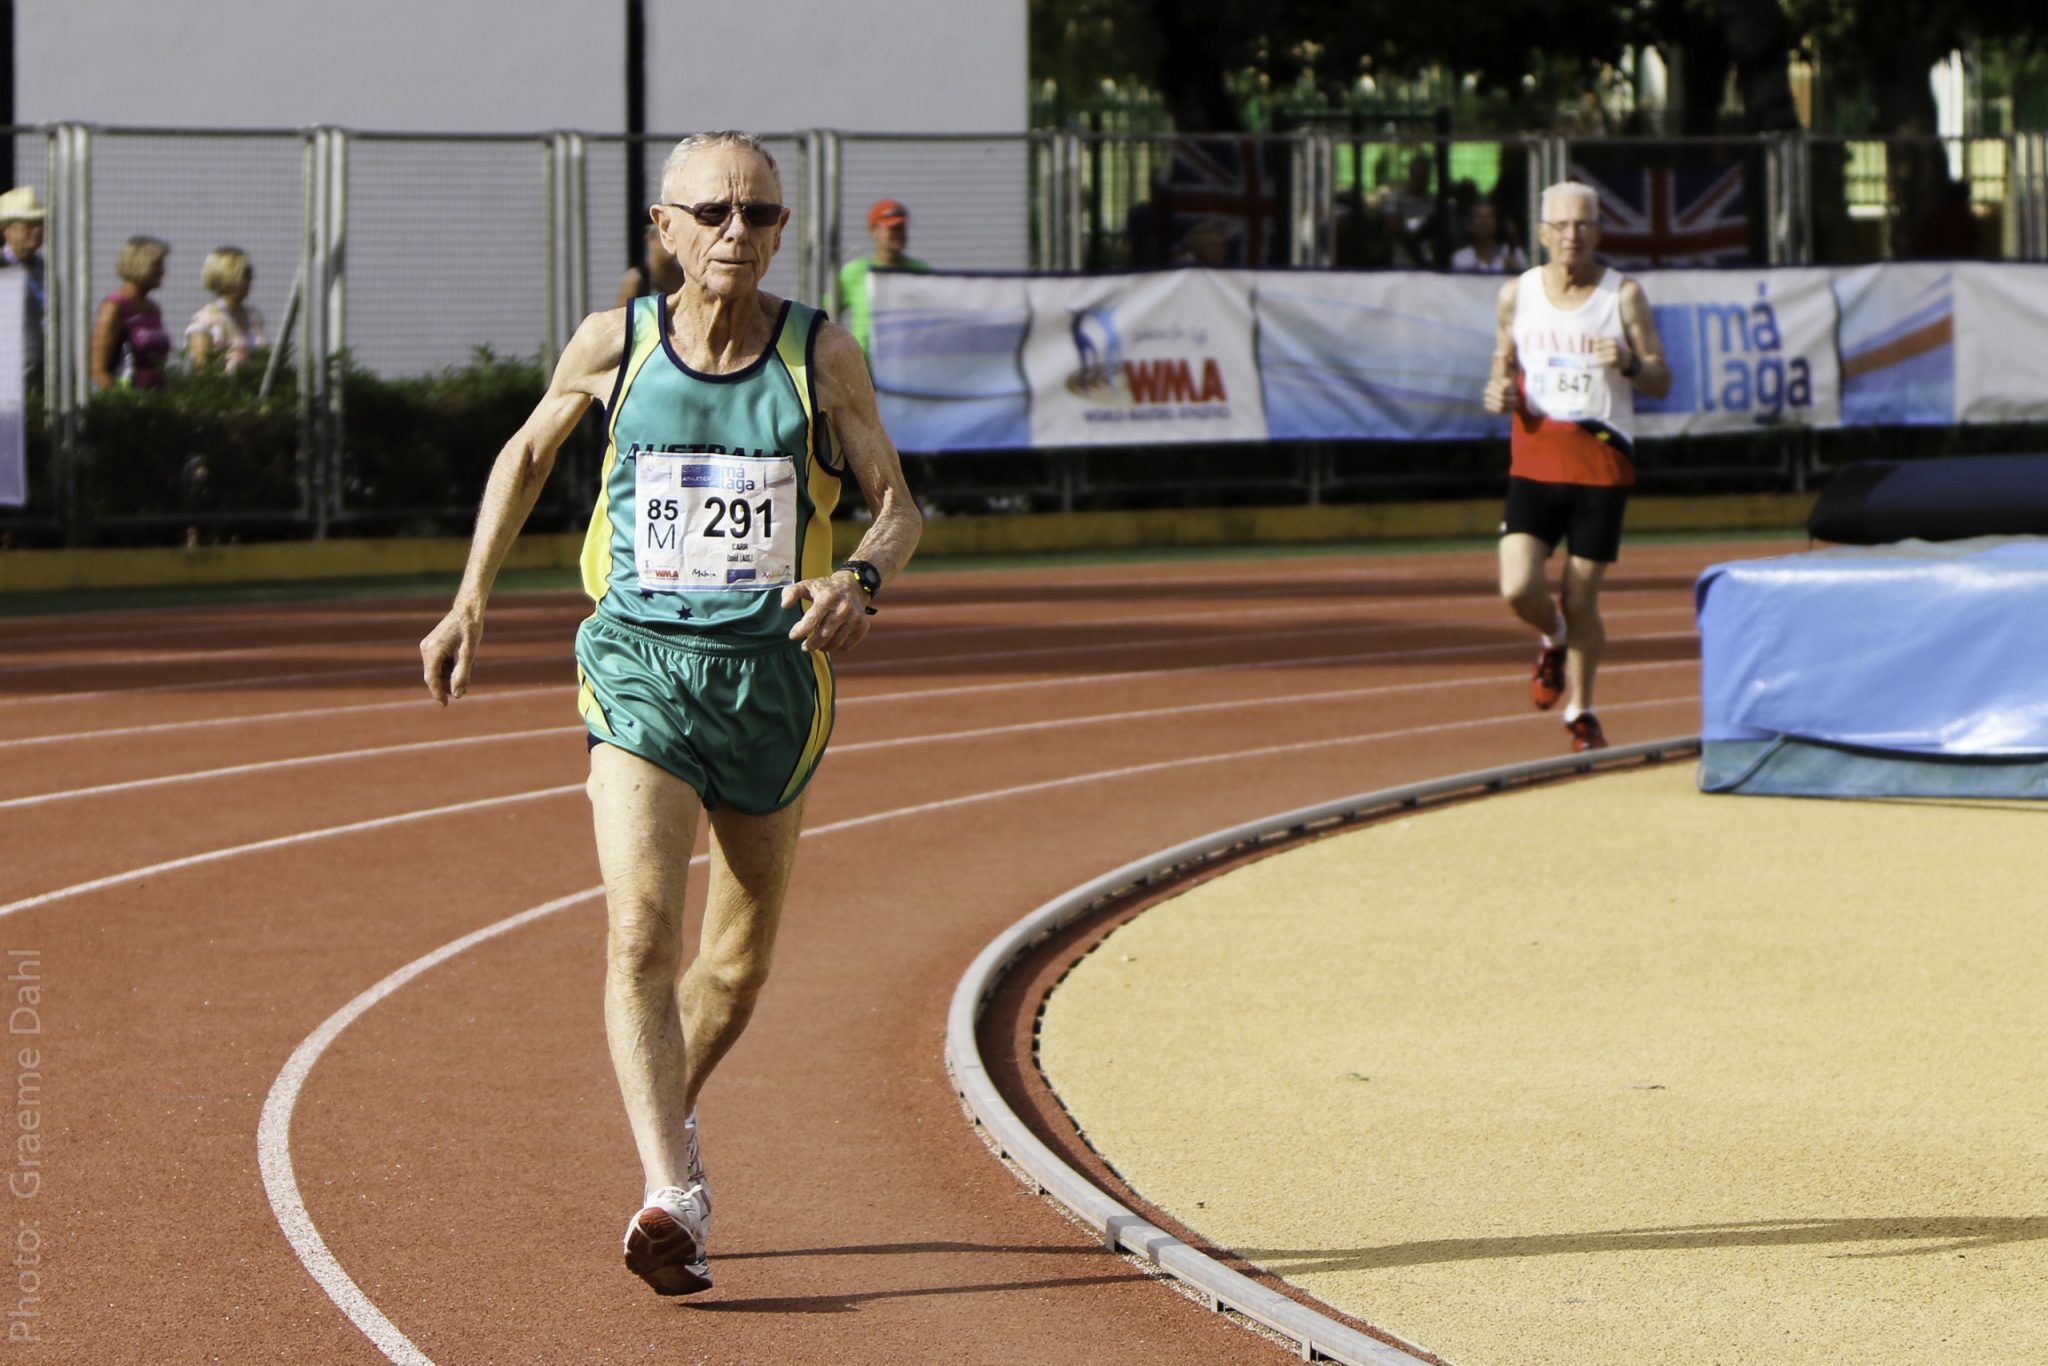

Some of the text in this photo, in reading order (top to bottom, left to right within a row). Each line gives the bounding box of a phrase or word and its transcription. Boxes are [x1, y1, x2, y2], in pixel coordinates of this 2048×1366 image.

[1698, 282, 1782, 353] má
[1123, 357, 1227, 405] WMA
[1558, 372, 1592, 392] 847
[1699, 355, 1812, 425] laga
[647, 498, 679, 521] 85
[703, 496, 773, 539] 291
[648, 522, 675, 550] M
[731, 543, 749, 551] CARR
[655, 569, 679, 578] WMA
